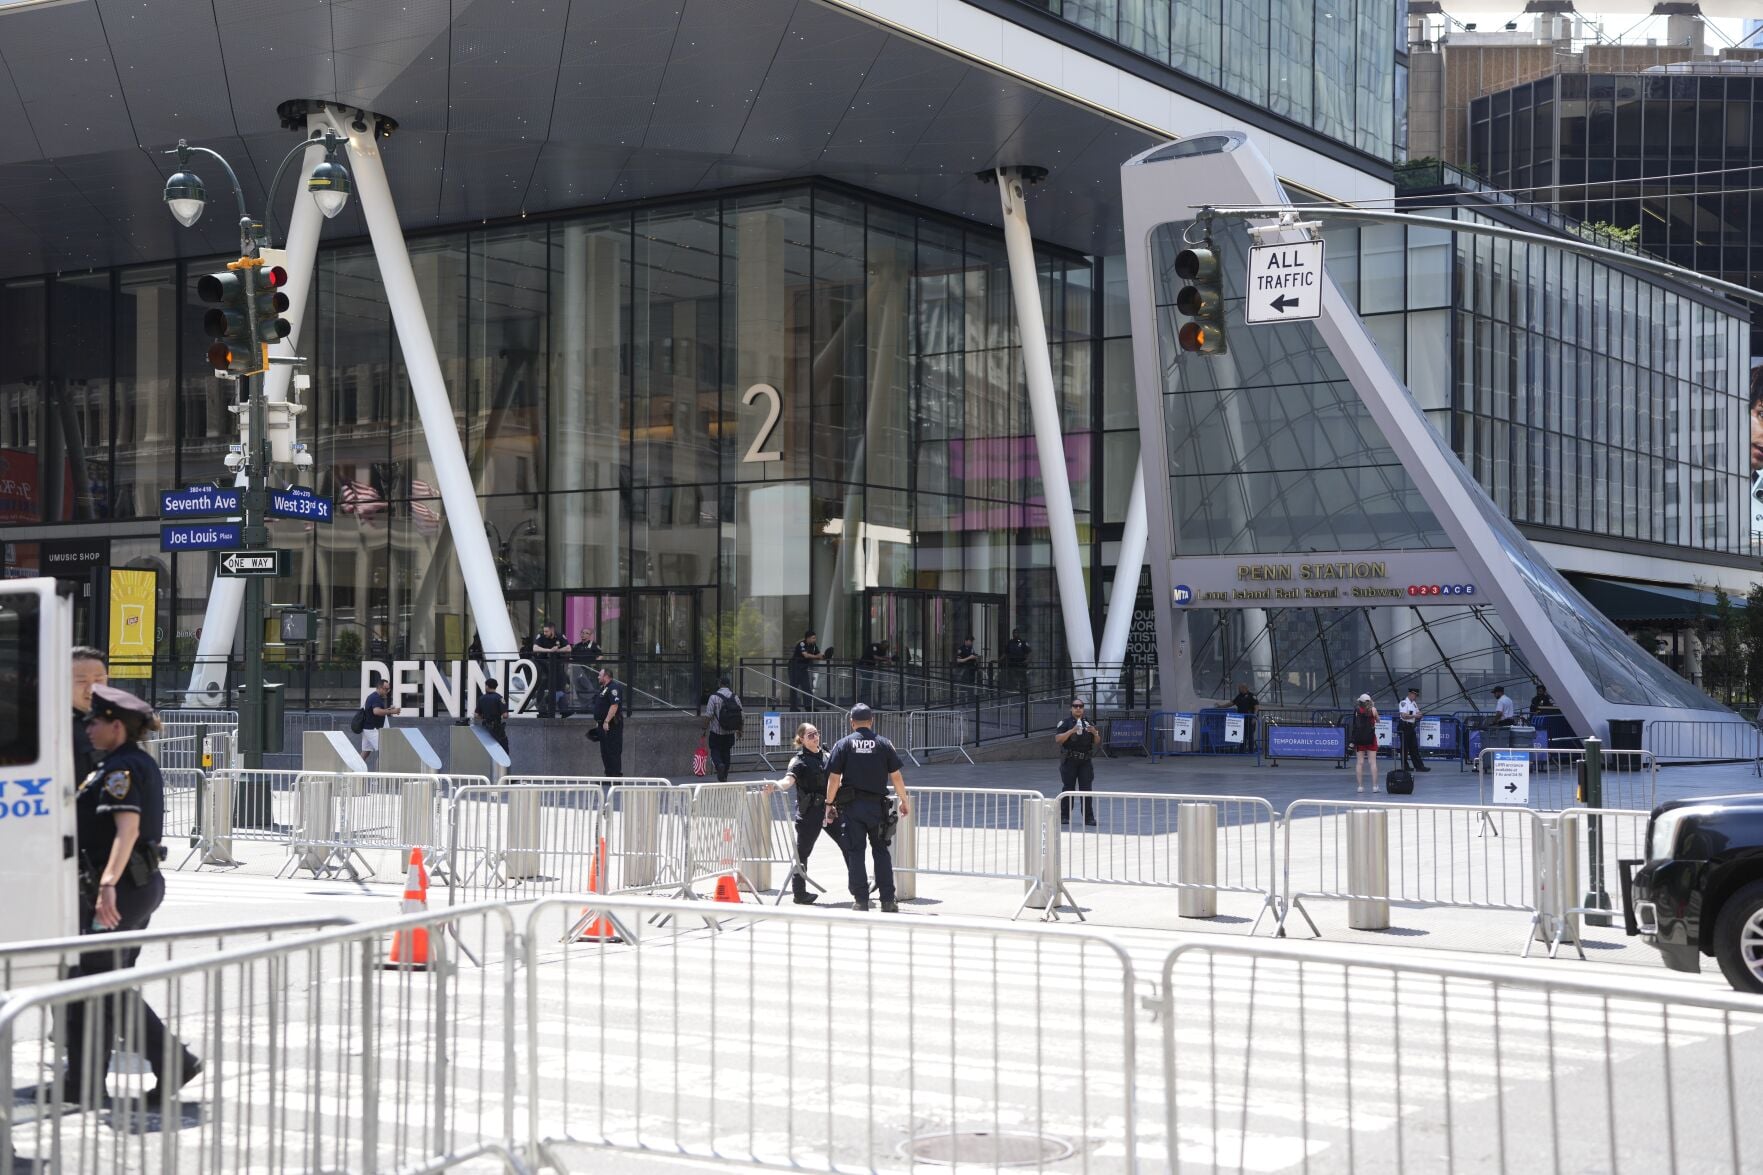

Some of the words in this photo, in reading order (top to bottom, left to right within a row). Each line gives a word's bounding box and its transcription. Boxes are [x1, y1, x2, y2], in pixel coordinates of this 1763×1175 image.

[1267, 250, 1304, 269] ALL
[1257, 271, 1313, 290] TRAFFIC
[742, 383, 782, 463] 2
[165, 495, 211, 511] Seventh
[214, 495, 237, 509] Ave
[274, 496, 298, 513] West
[299, 500, 316, 514] 33rd
[318, 502, 328, 516] St
[170, 531, 188, 545] Joe
[190, 529, 218, 543] Louis
[49, 553, 78, 562] UMUSIC
[79, 552, 100, 561] SHOP
[228, 558, 244, 568] ONE
[251, 558, 268, 567] WAY
[1237, 564, 1292, 581] PENN
[1300, 561, 1386, 580] STATION
[1173, 588, 1189, 601] MTA
[1232, 588, 1271, 599] Island
[1275, 586, 1300, 599] Rail
[1304, 586, 1338, 599] Road
[1351, 585, 1405, 600] Subway
[1131, 653, 1155, 664] THE
[852, 739, 876, 749] NYPD
